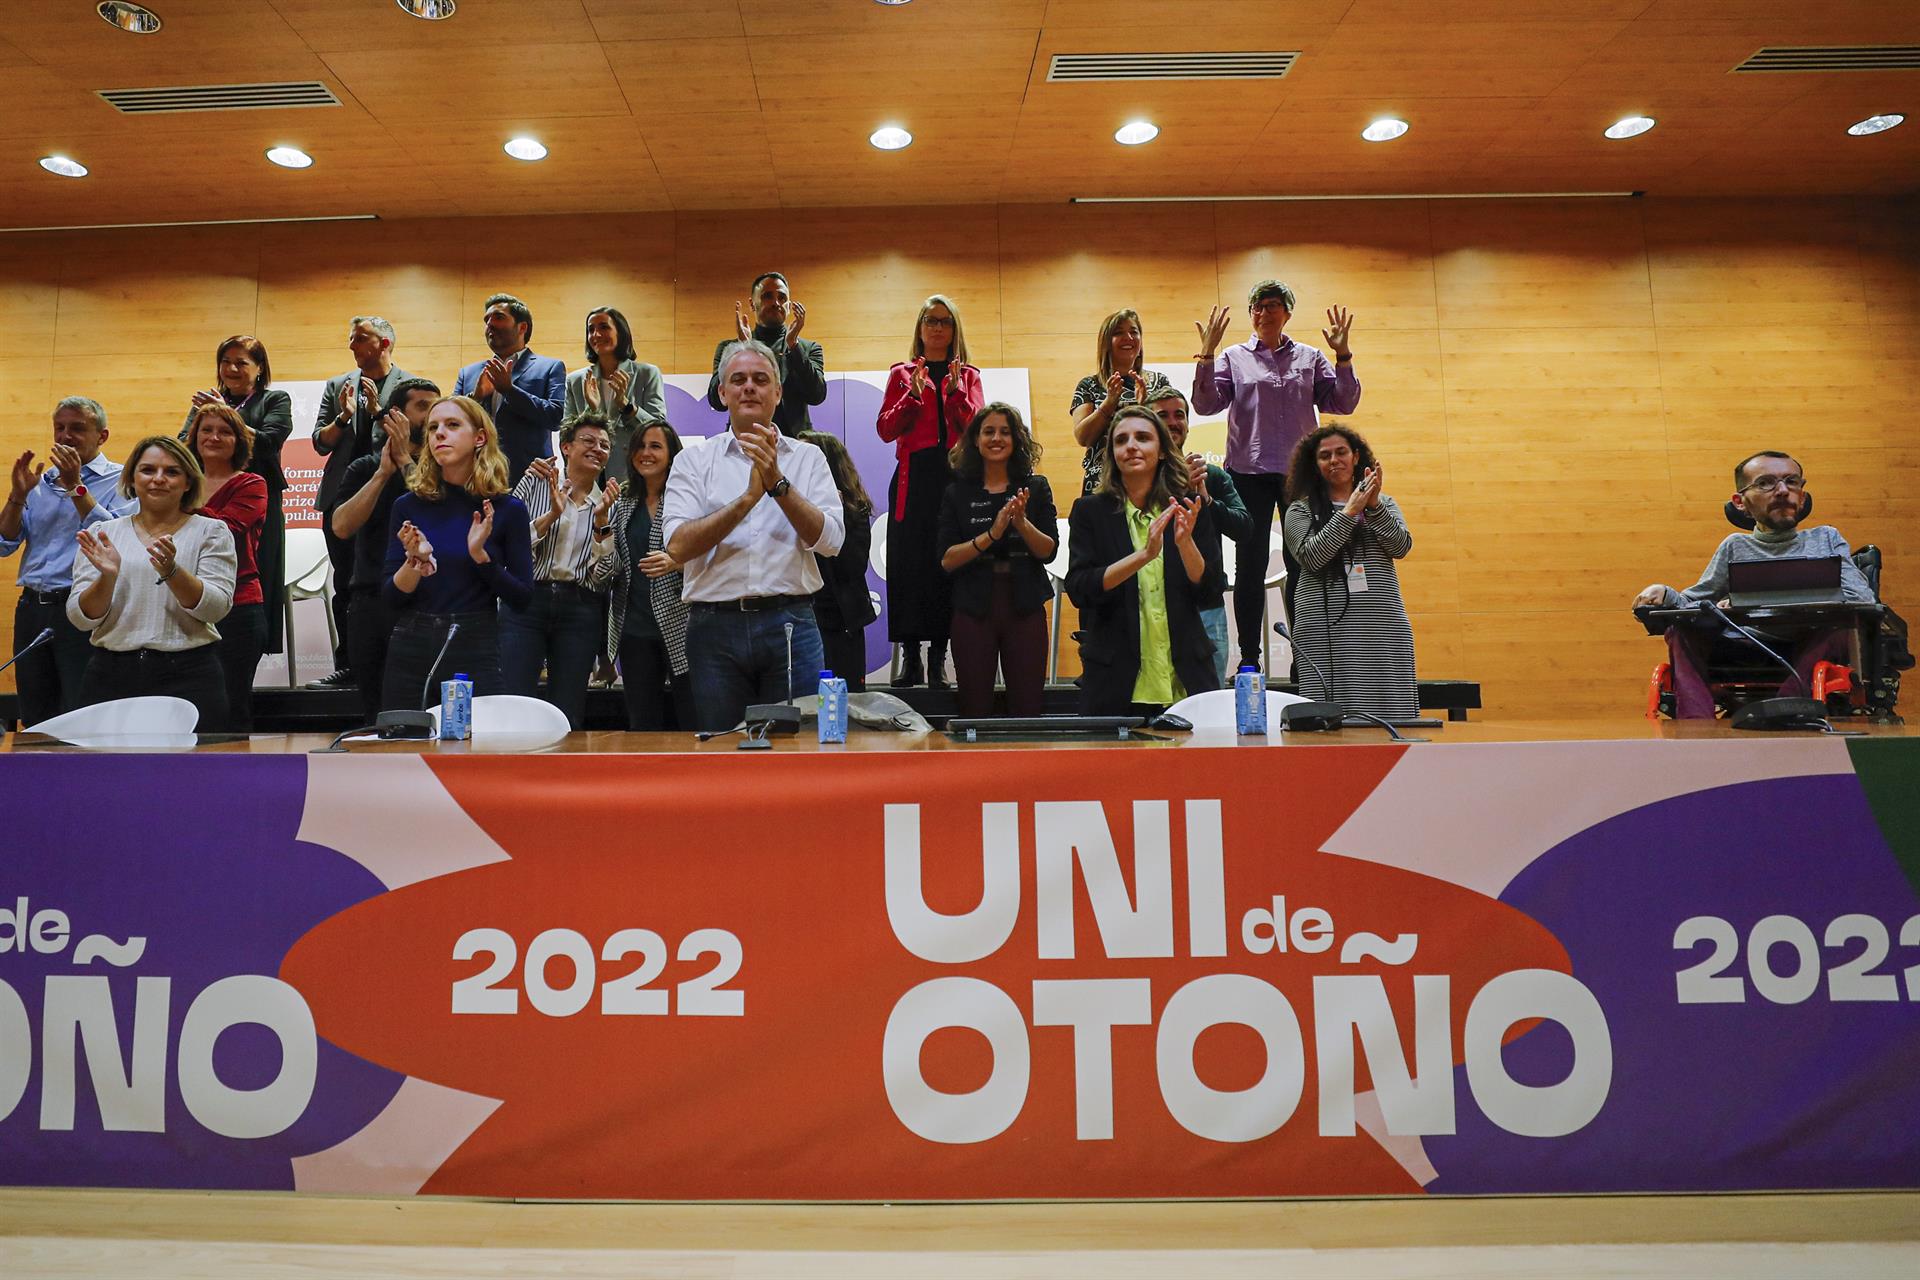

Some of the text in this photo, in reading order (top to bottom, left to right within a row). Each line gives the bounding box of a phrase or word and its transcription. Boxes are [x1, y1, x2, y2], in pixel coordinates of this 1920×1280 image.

[282, 481, 320, 492] ocrá
[884, 799, 1334, 963] UNI de
[451, 928, 746, 1017] 2022
[1673, 914, 1920, 1005] 202
[0, 934, 319, 1140] ÑO
[882, 932, 1613, 1144] OTOÑO
